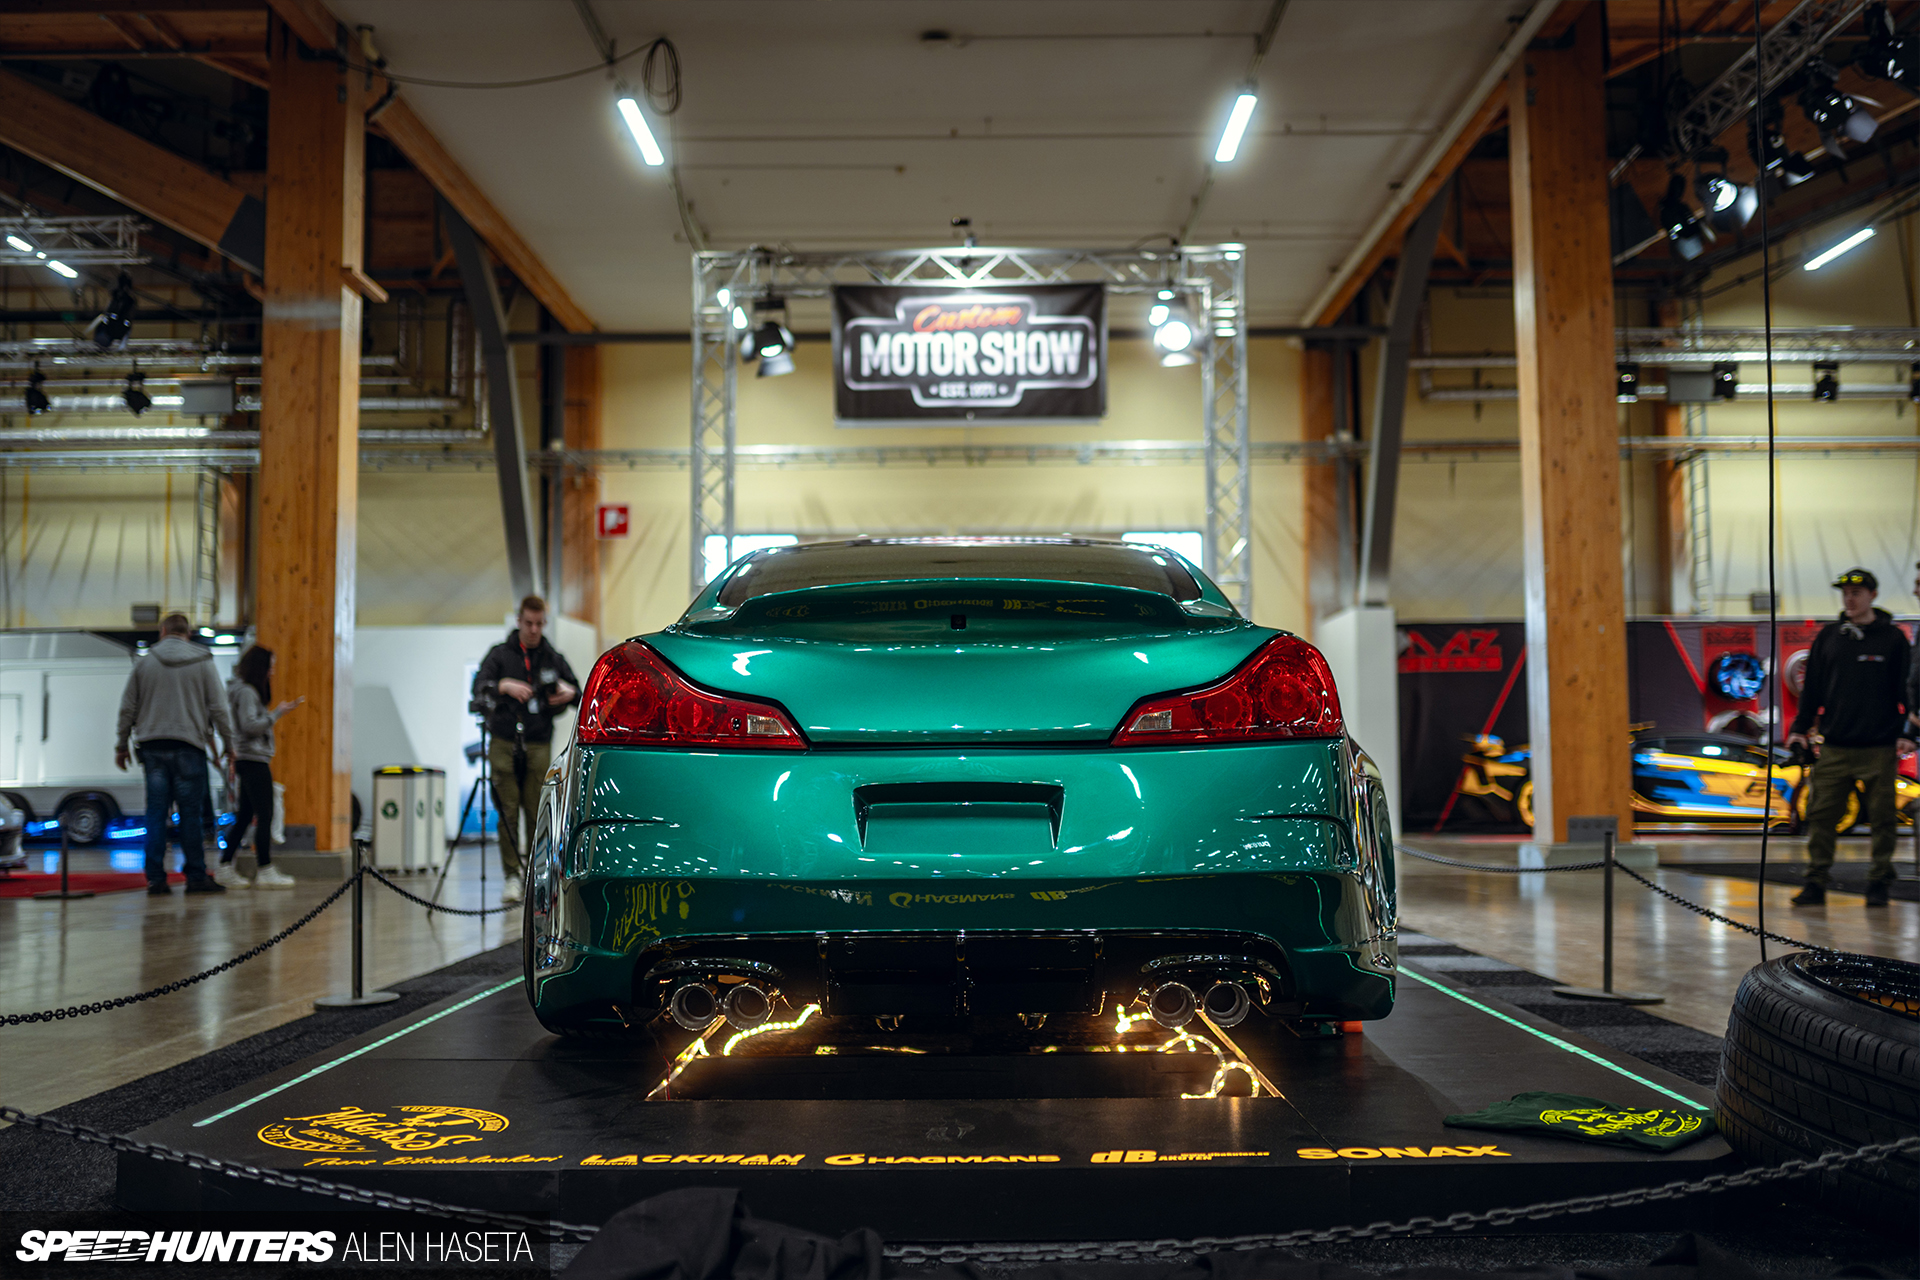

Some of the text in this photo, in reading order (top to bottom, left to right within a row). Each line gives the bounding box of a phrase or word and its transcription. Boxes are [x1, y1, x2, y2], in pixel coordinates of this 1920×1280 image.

[860, 330, 1083, 377] MOTOR SHOW
[580, 1154, 805, 1163] LACKMAN
[868, 1154, 1062, 1163] HAGMANS
[1090, 1150, 1157, 1163] dB
[1296, 1146, 1512, 1160] SONAX
